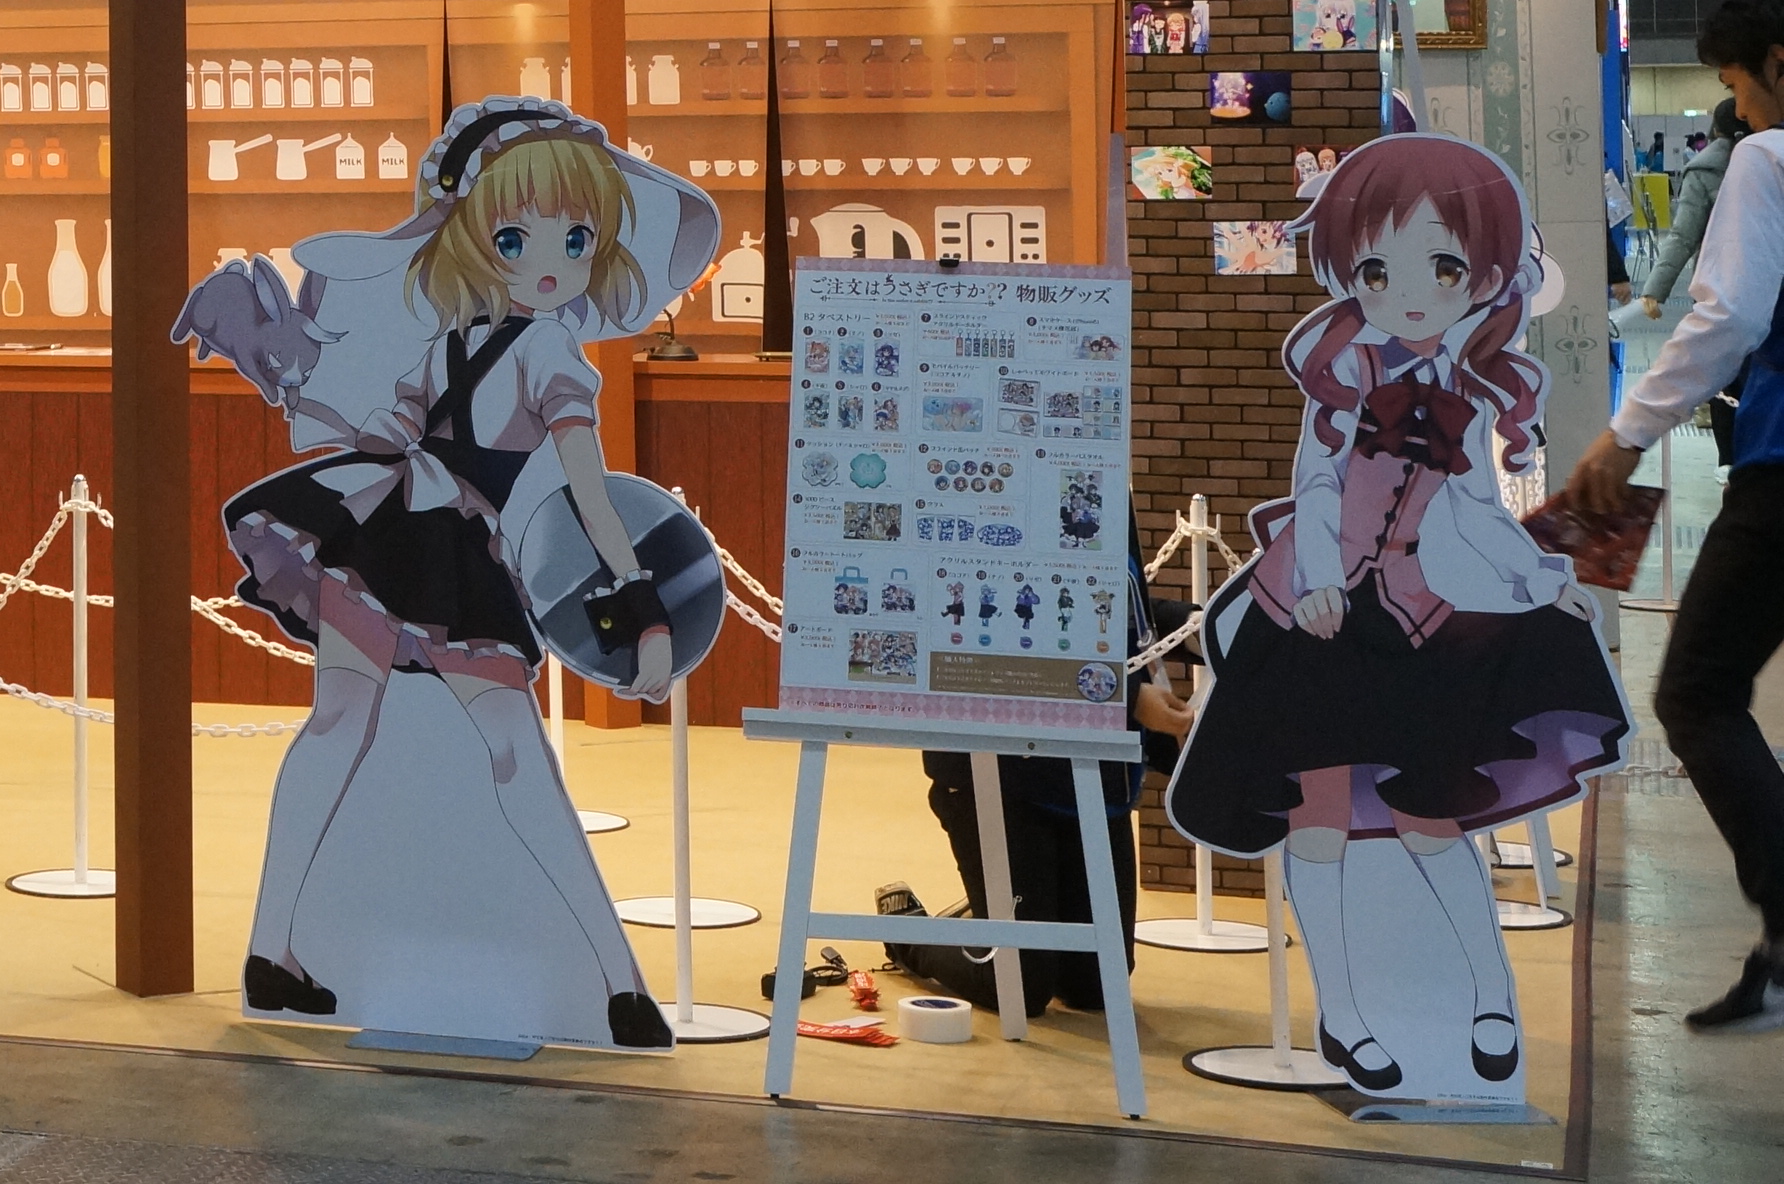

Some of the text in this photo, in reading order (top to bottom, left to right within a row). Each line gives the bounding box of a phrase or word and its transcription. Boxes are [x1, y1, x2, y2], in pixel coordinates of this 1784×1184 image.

[339, 158, 362, 166] MILK
[381, 157, 405, 166] MILK
[810, 274, 1112, 304] ご注文はうさぎですか?? 物販グッズ
[880, 894, 909, 915] NIKE
